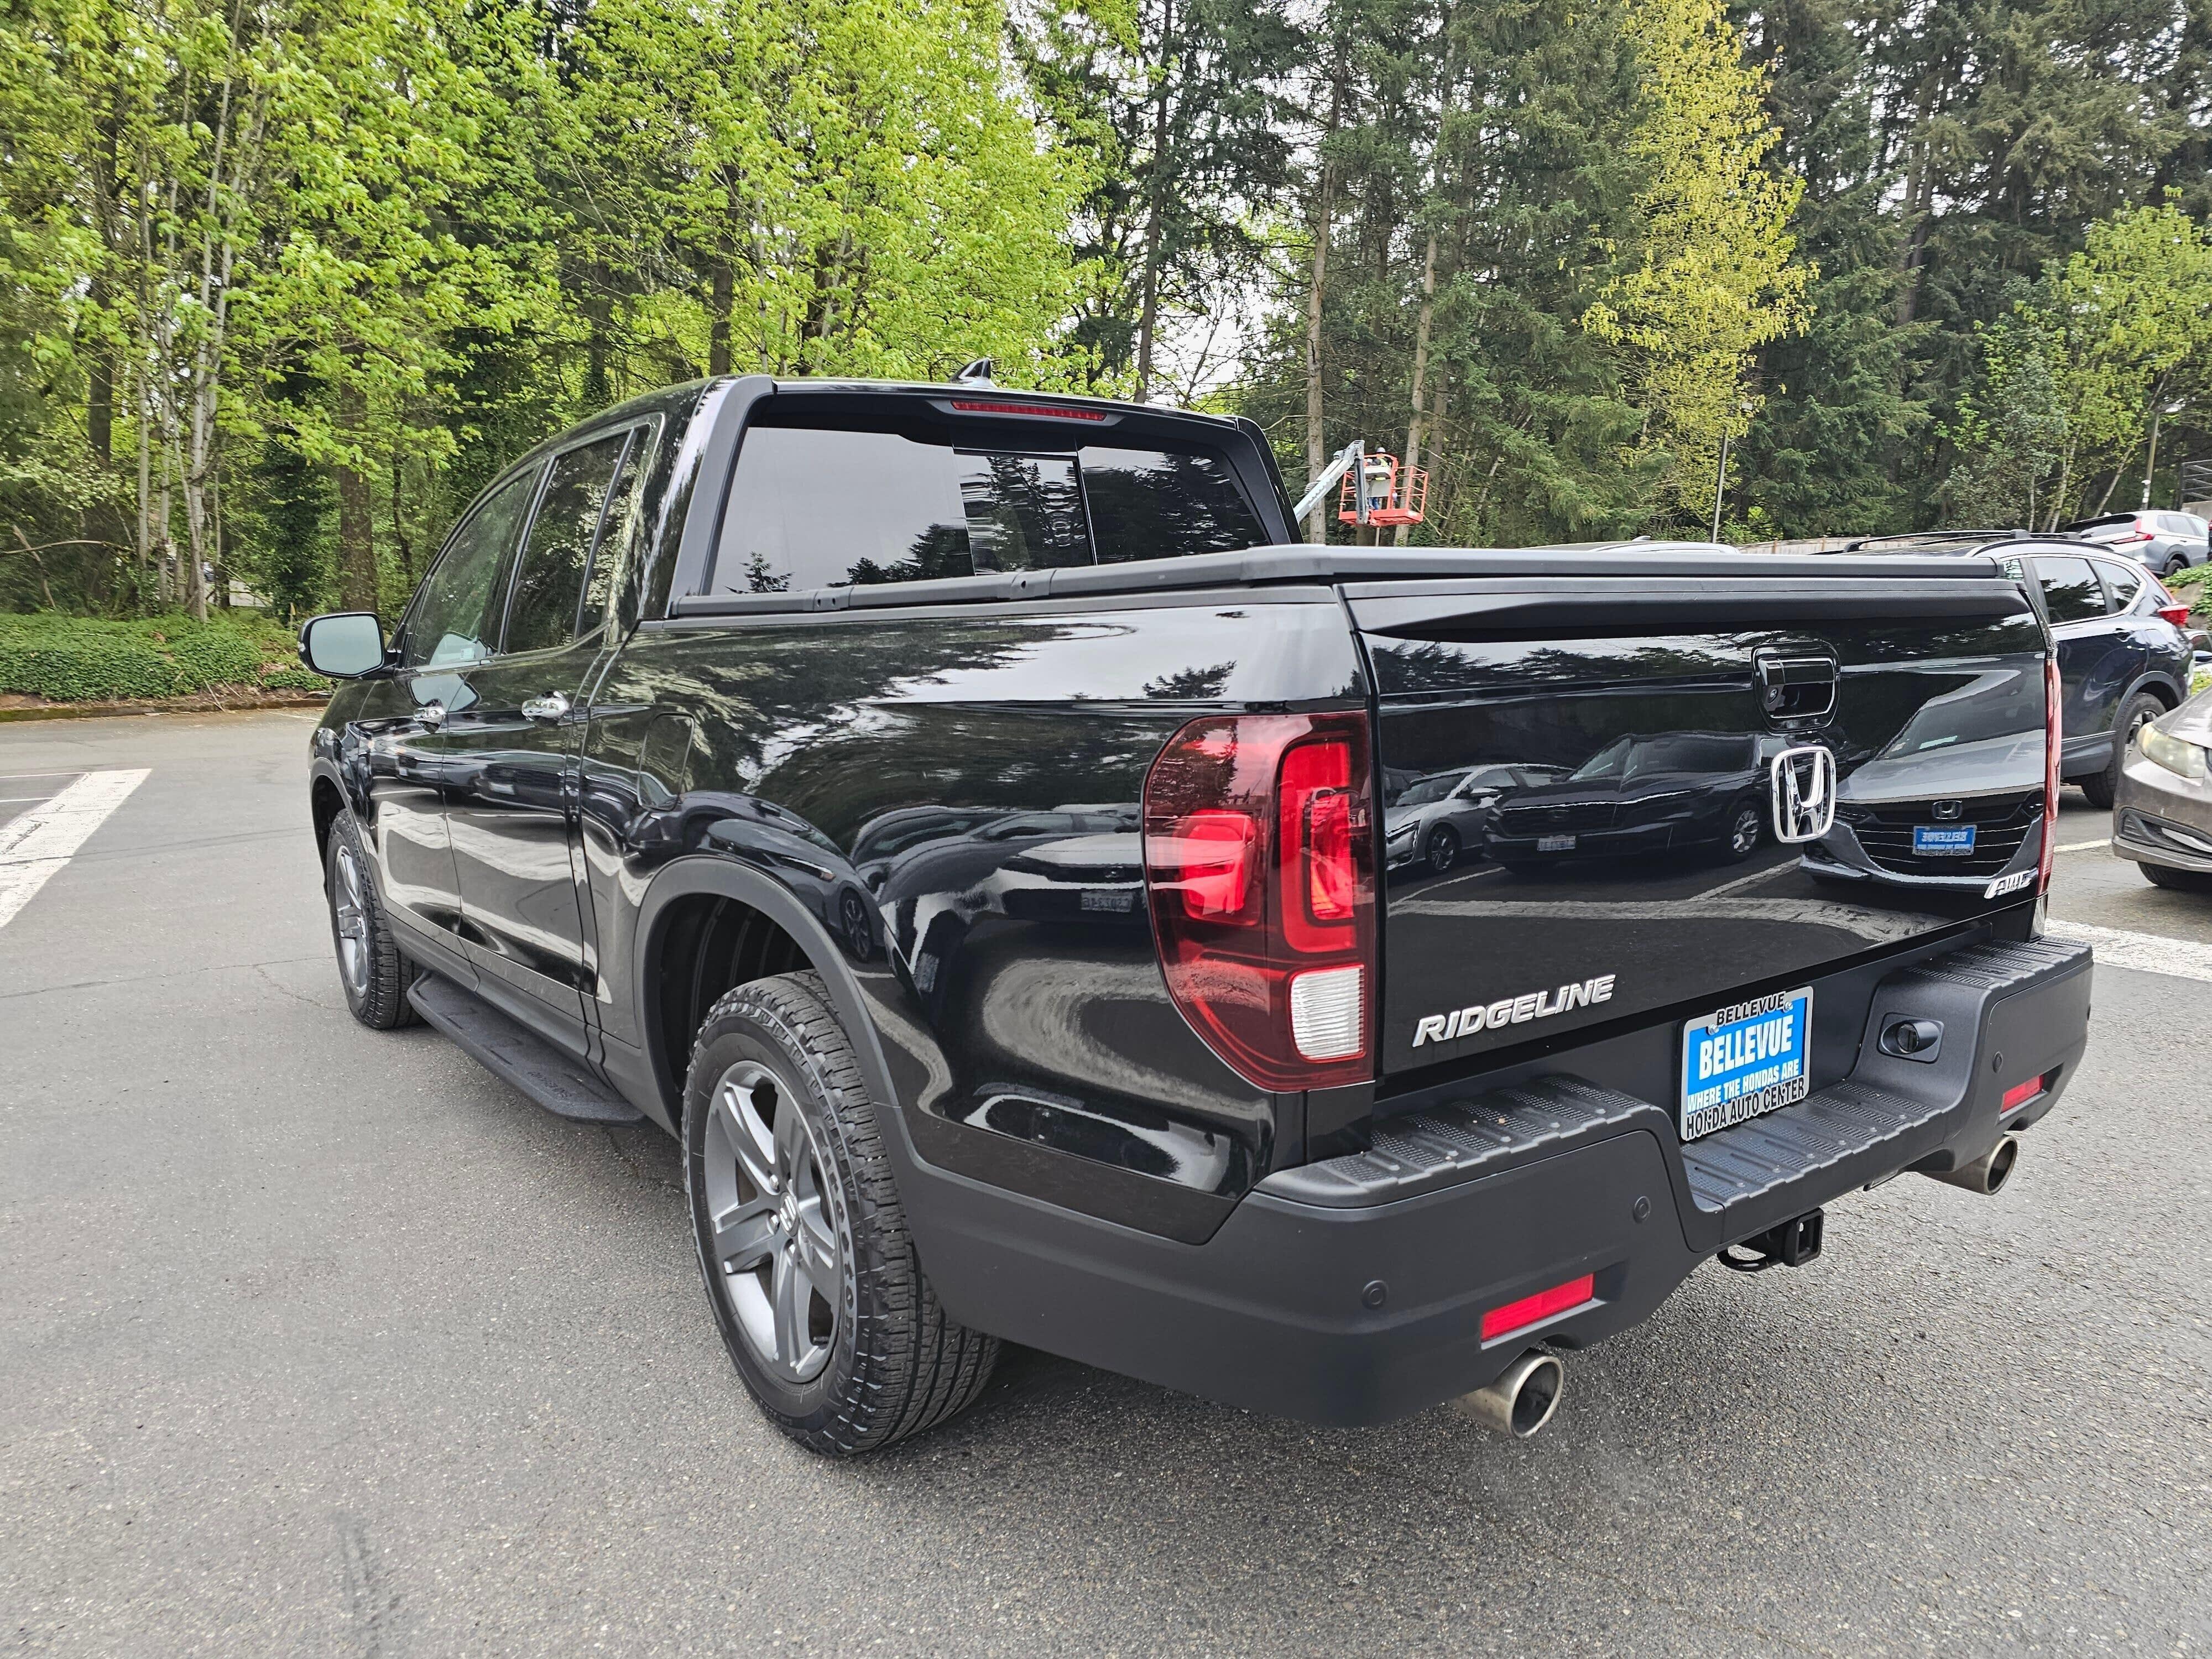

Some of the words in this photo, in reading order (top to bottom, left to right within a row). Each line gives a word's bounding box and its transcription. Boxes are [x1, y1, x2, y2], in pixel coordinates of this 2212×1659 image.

[1984, 867, 2038, 899] AWD
[1412, 974, 1616, 1047] RIDGELINE
[1717, 993, 1785, 1025] BELLEVUE
[1699, 1014, 1793, 1080] BELLEVUE
[1687, 1086, 1721, 1113] WHERE
[1724, 1078, 1741, 1099] THE
[1743, 1066, 1779, 1093] HONDAS
[1781, 1059, 1799, 1081] ARE
[1687, 1105, 1728, 1139] HONDA
[1729, 1092, 1759, 1123] AUTO
[1764, 1077, 1804, 1109] CENTER
